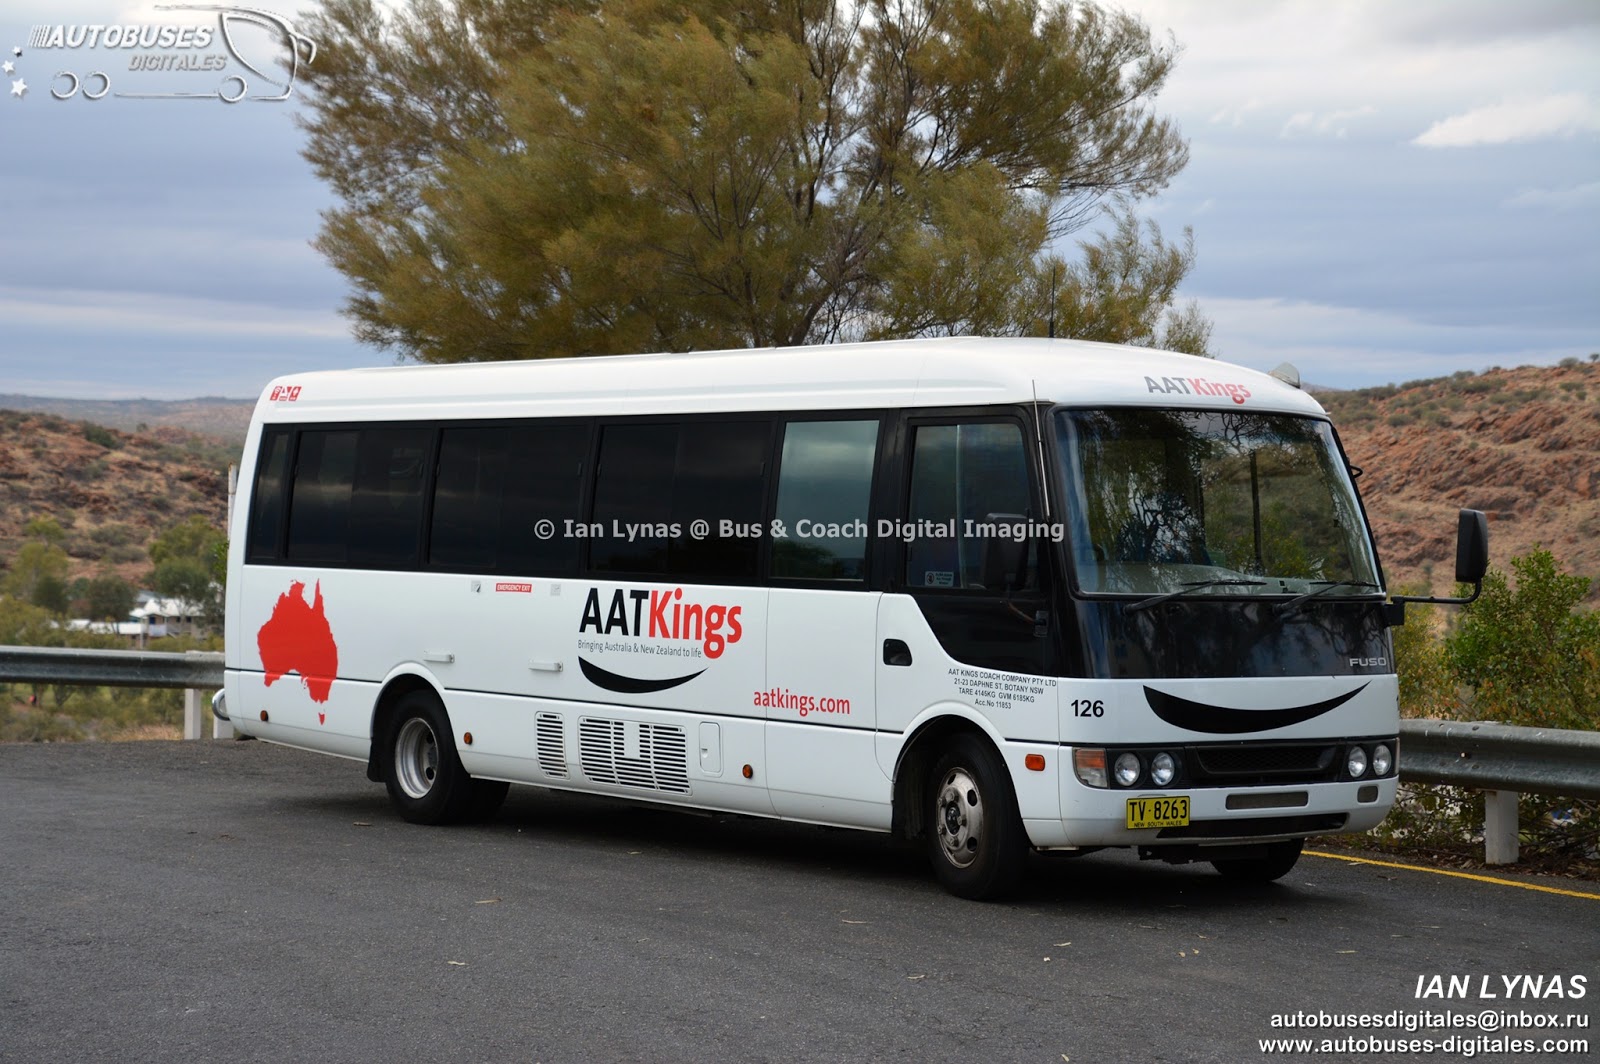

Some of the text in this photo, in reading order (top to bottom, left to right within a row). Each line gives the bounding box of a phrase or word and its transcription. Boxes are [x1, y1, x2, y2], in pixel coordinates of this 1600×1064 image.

[1144, 376, 1251, 404] AATKings
[497, 583, 531, 592] EMERGENCY EXIT
[579, 587, 742, 659] AATKings
[578, 639, 701, 658] Bringing Australia & New Zealand to life
[1349, 657, 1387, 667] FUSO
[948, 668, 1057, 687] AAT KINGS COACH COMPANY PTY LTD
[954, 677, 968, 686] 21-23
[970, 679, 993, 689] DAPHNE
[1004, 683, 1029, 693] BOTANY
[1029, 686, 1044, 695] NSW
[753, 687, 851, 717] aatkings.com
[959, 687, 973, 696] TARE
[998, 692, 1012, 700] GVM
[1071, 699, 1105, 718] 126
